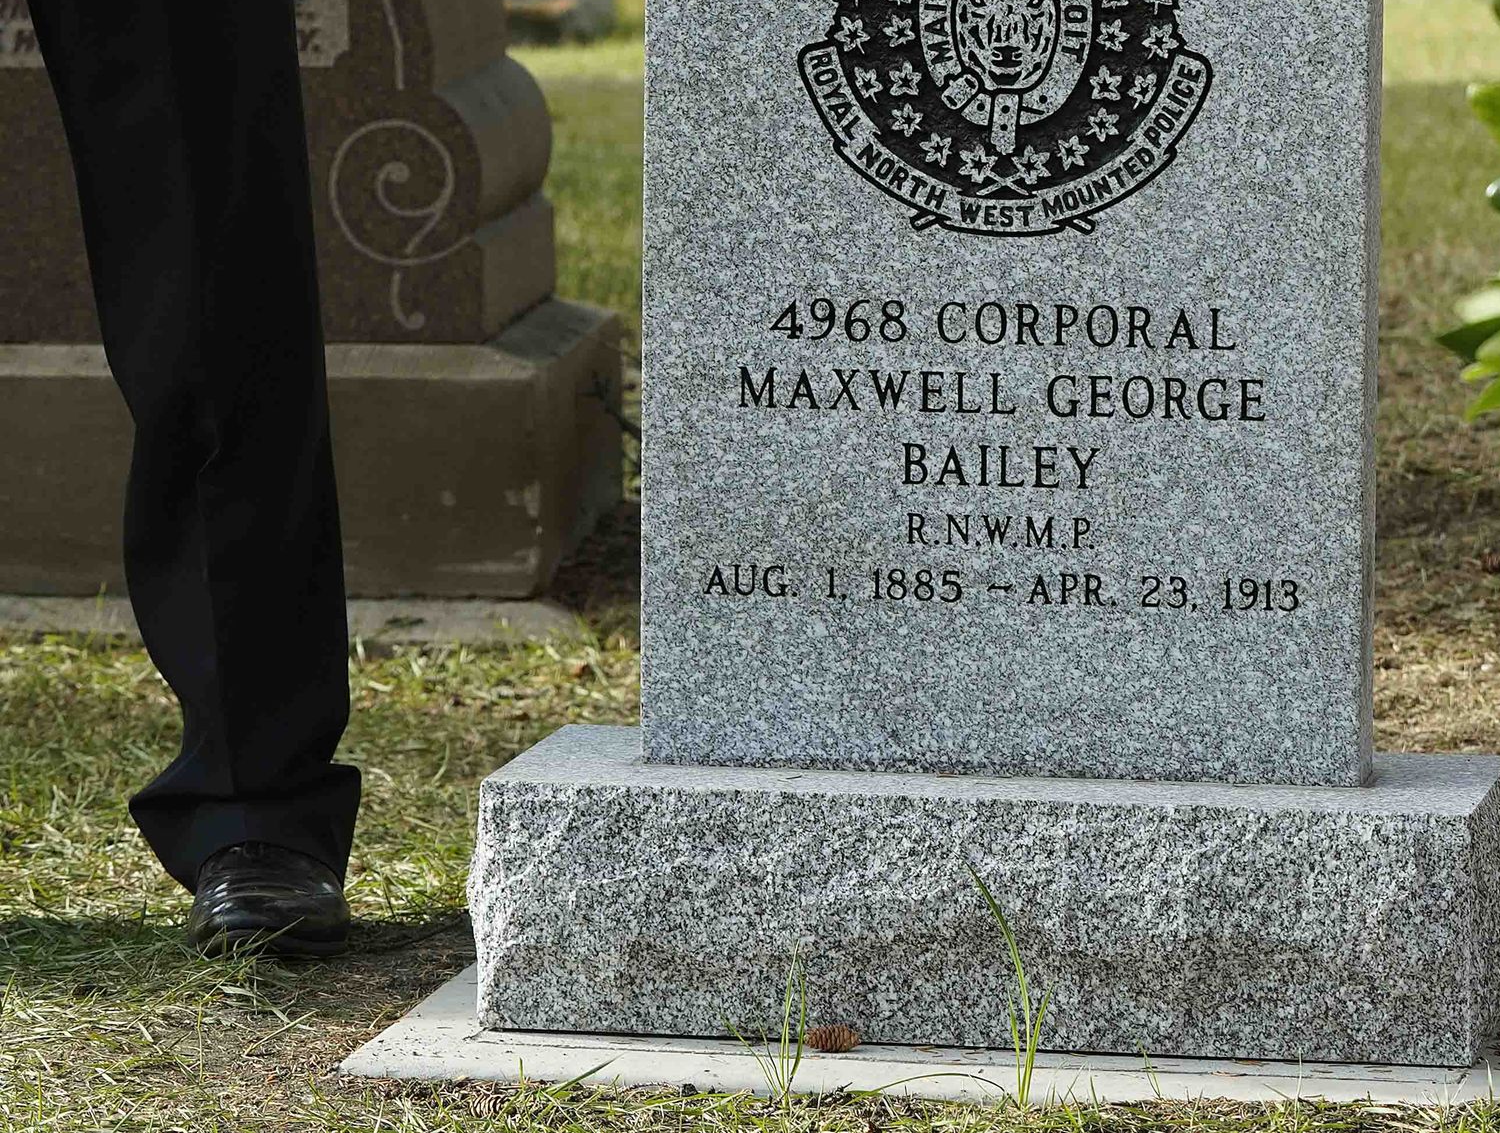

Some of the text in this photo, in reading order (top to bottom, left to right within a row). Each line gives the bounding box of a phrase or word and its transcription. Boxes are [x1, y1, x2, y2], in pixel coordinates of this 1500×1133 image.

[807, 50, 1204, 229] ROYAL NORTH WEST MOUNTED POLICE
[769, 298, 1238, 352] 4968 CORPORAL
[737, 366, 1267, 423] MAXWELL GEORGE
[901, 441, 1102, 490] BAILEY
[905, 512, 1096, 550] R.N.W.M.P.
[702, 565, 798, 598] AUG.
[825, 567, 849, 600] 1,
[871, 569, 964, 604] 1885
[1027, 573, 1118, 608] APR.
[1140, 575, 1199, 614] 23,
[1220, 578, 1301, 613] 1913
